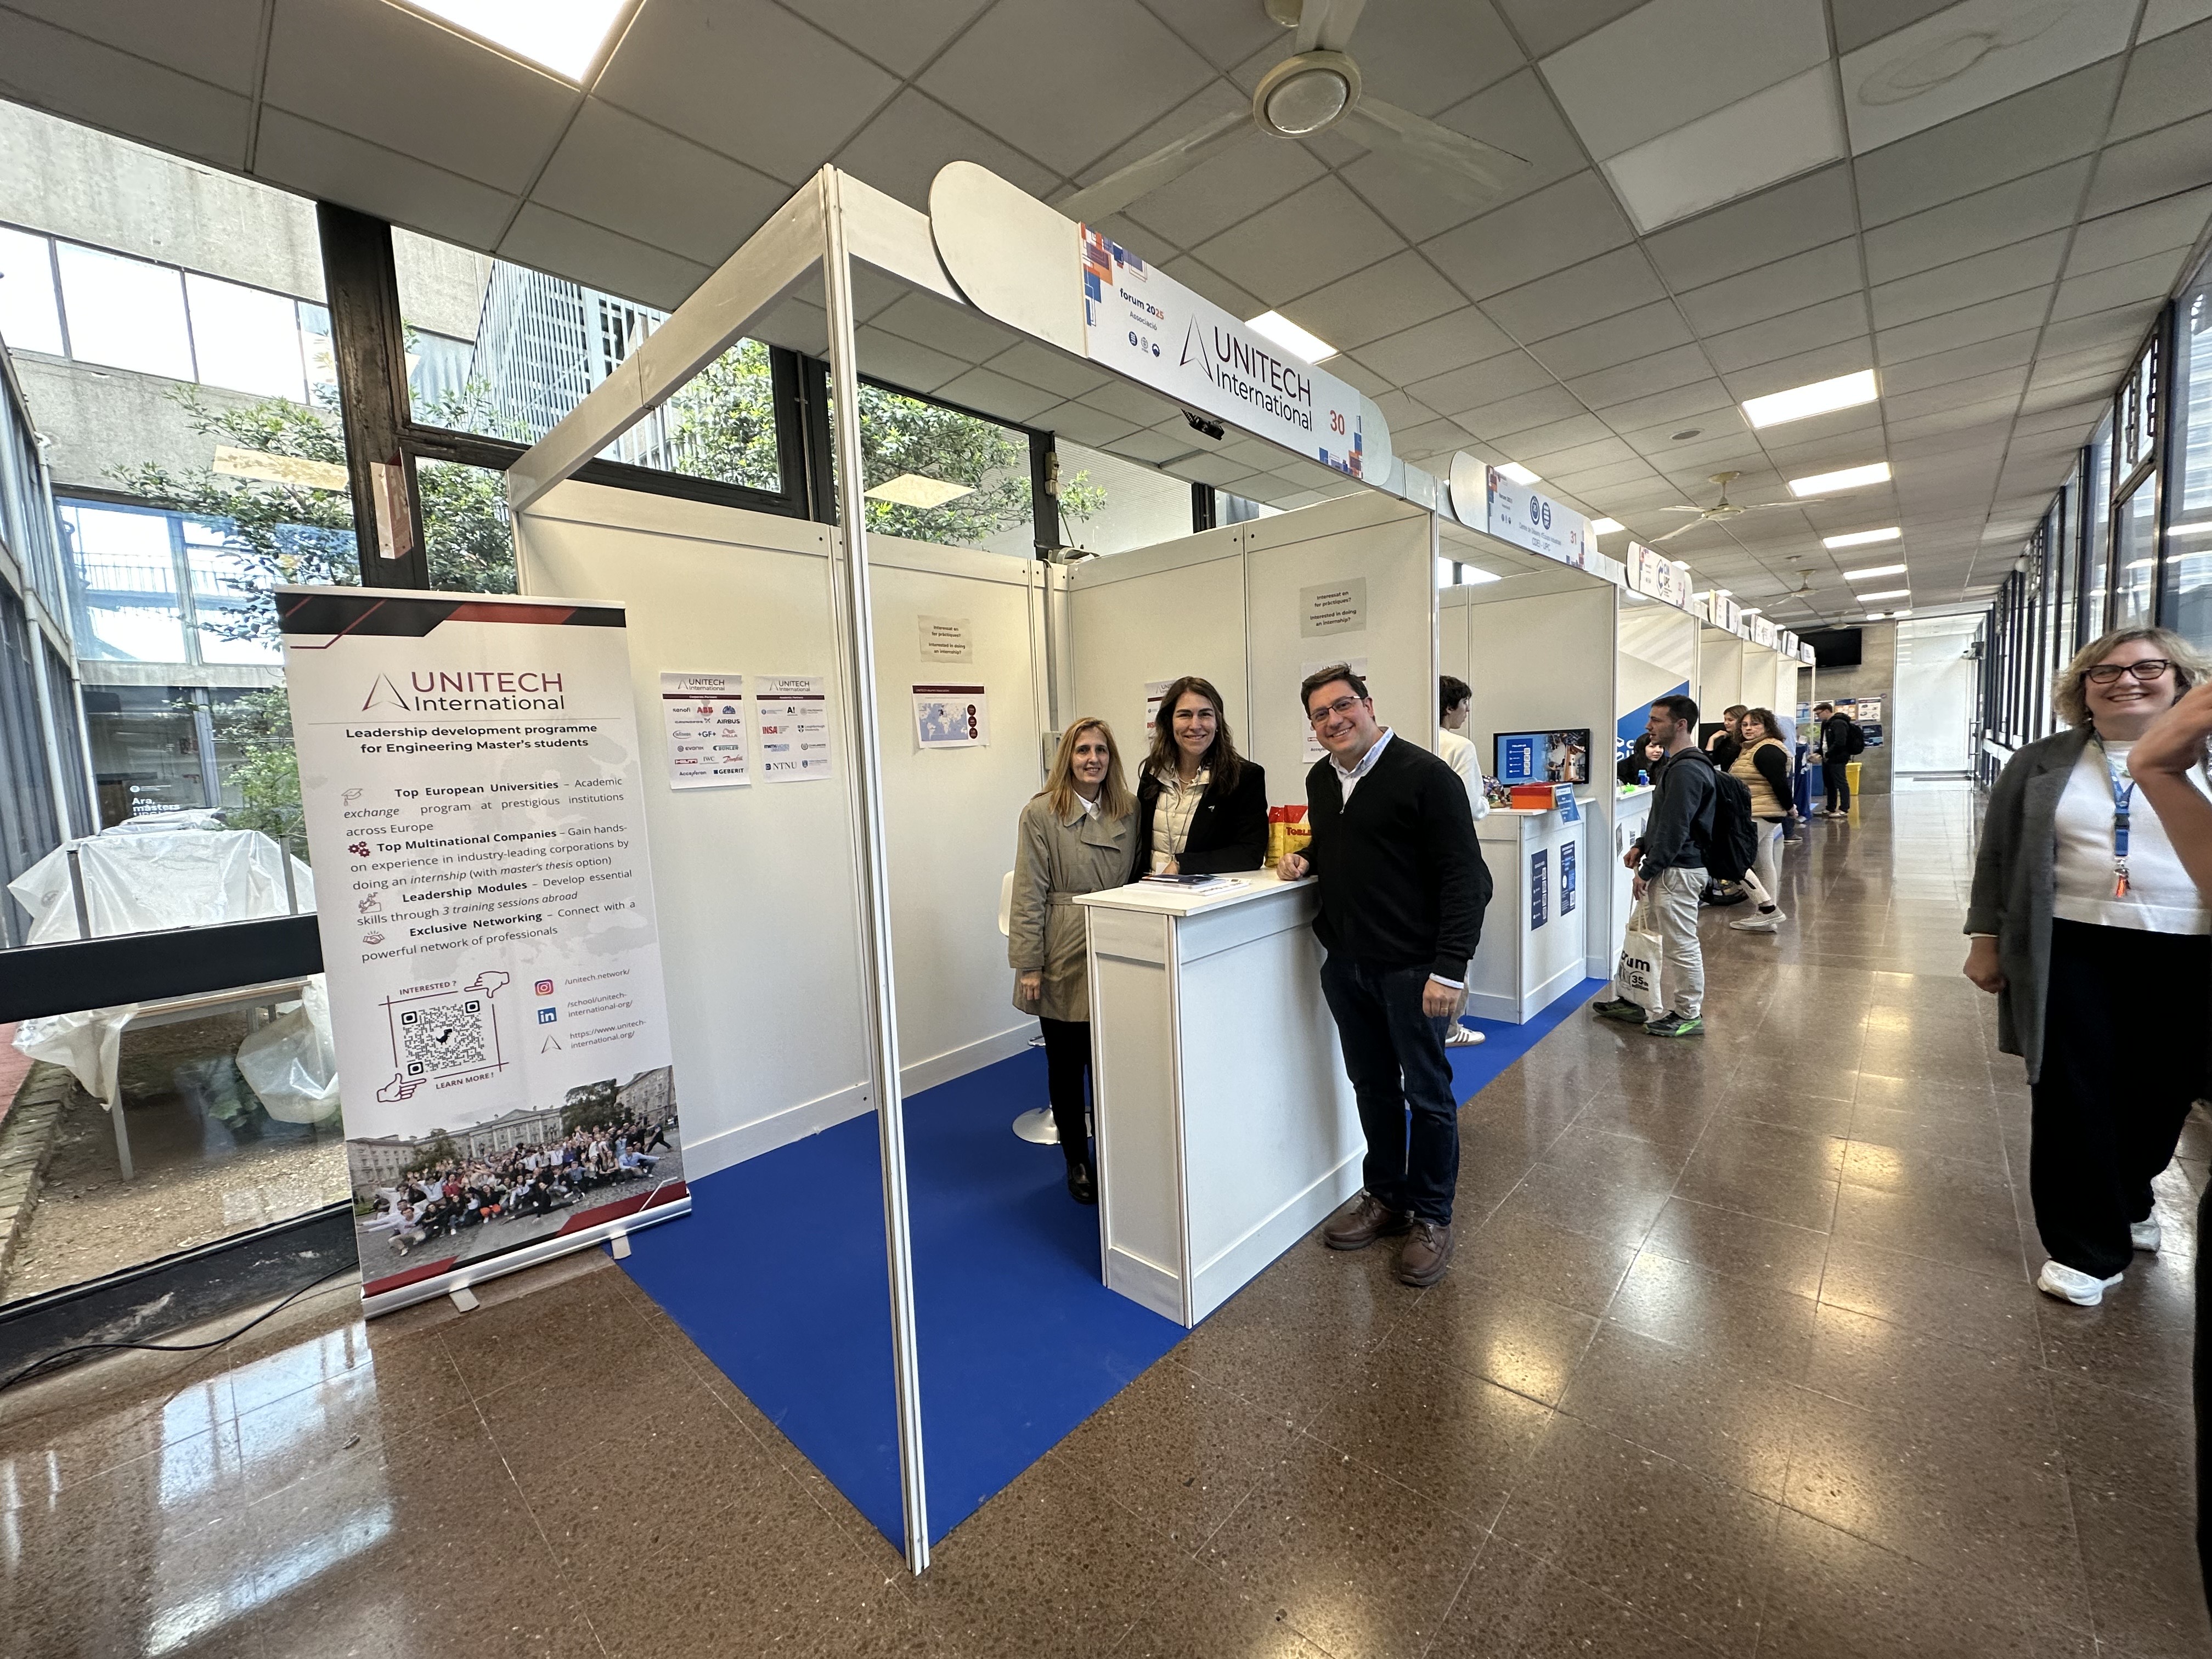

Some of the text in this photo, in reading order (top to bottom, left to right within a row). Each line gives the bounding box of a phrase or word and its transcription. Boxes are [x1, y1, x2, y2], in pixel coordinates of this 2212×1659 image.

[1120, 288, 1165, 320] forum 2025
[1130, 311, 1158, 331] Associació
[1214, 325, 1312, 407] UNITECH
[1216, 363, 1313, 432] International
[1329, 409, 1345, 436] 30
[1543, 541, 1551, 552] UPC
[1570, 531, 1577, 545] 31
[1317, 592, 1341, 600] Interessat
[1310, 612, 1335, 620] Interested
[1323, 617, 1351, 625] internship?
[411, 672, 563, 693] UNITECH
[415, 695, 565, 711] International
[346, 725, 597, 738] Leadership development programme
[762, 726, 778, 735] INSA
[360, 738, 589, 754] for Engineering Master's students
[772, 761, 797, 770] NTNU
[394, 789, 419, 799] Top
[425, 786, 484, 797] European
[490, 781, 558, 792] Universities
[574, 777, 623, 788] Academic
[344, 794, 624, 819] exchange program at prestigious institutions
[346, 823, 433, 837] across Europe
[376, 843, 402, 853] Top
[405, 834, 490, 850] Multinational
[493, 830, 557, 842] Companies
[568, 827, 591, 836] Gain
[594, 824, 628, 834] hands-
[351, 864, 367, 872] on
[371, 857, 438, 872] experience
[458, 847, 547, 862] industry-leading
[550, 842, 614, 854] corporations
[617, 839, 629, 849] by
[353, 856, 612, 890] doing an internship (with master's thesis option)
[402, 888, 472, 902] Leadership
[477, 882, 528, 894] Modules
[543, 876, 585, 887] Develop
[589, 869, 632, 882] essential
[357, 891, 578, 926] skills through 3 training sessions abroad
[409, 923, 467, 936] Exclusive
[473, 913, 543, 928] Networking
[557, 905, 600, 917] Connect
[603, 901, 625, 911] with
[362, 926, 558, 964] powerful network of professionals
[565, 968, 630, 985] /unitech.network/
[399, 981, 450, 995] INTERESTED
[567, 992, 627, 1008] /school/unitech-
[538, 1011, 555, 1023] in
[569, 1019, 646, 1039] https://www.unitech-
[436, 1079, 463, 1090] LEARN
[465, 1073, 489, 1084] MORE
